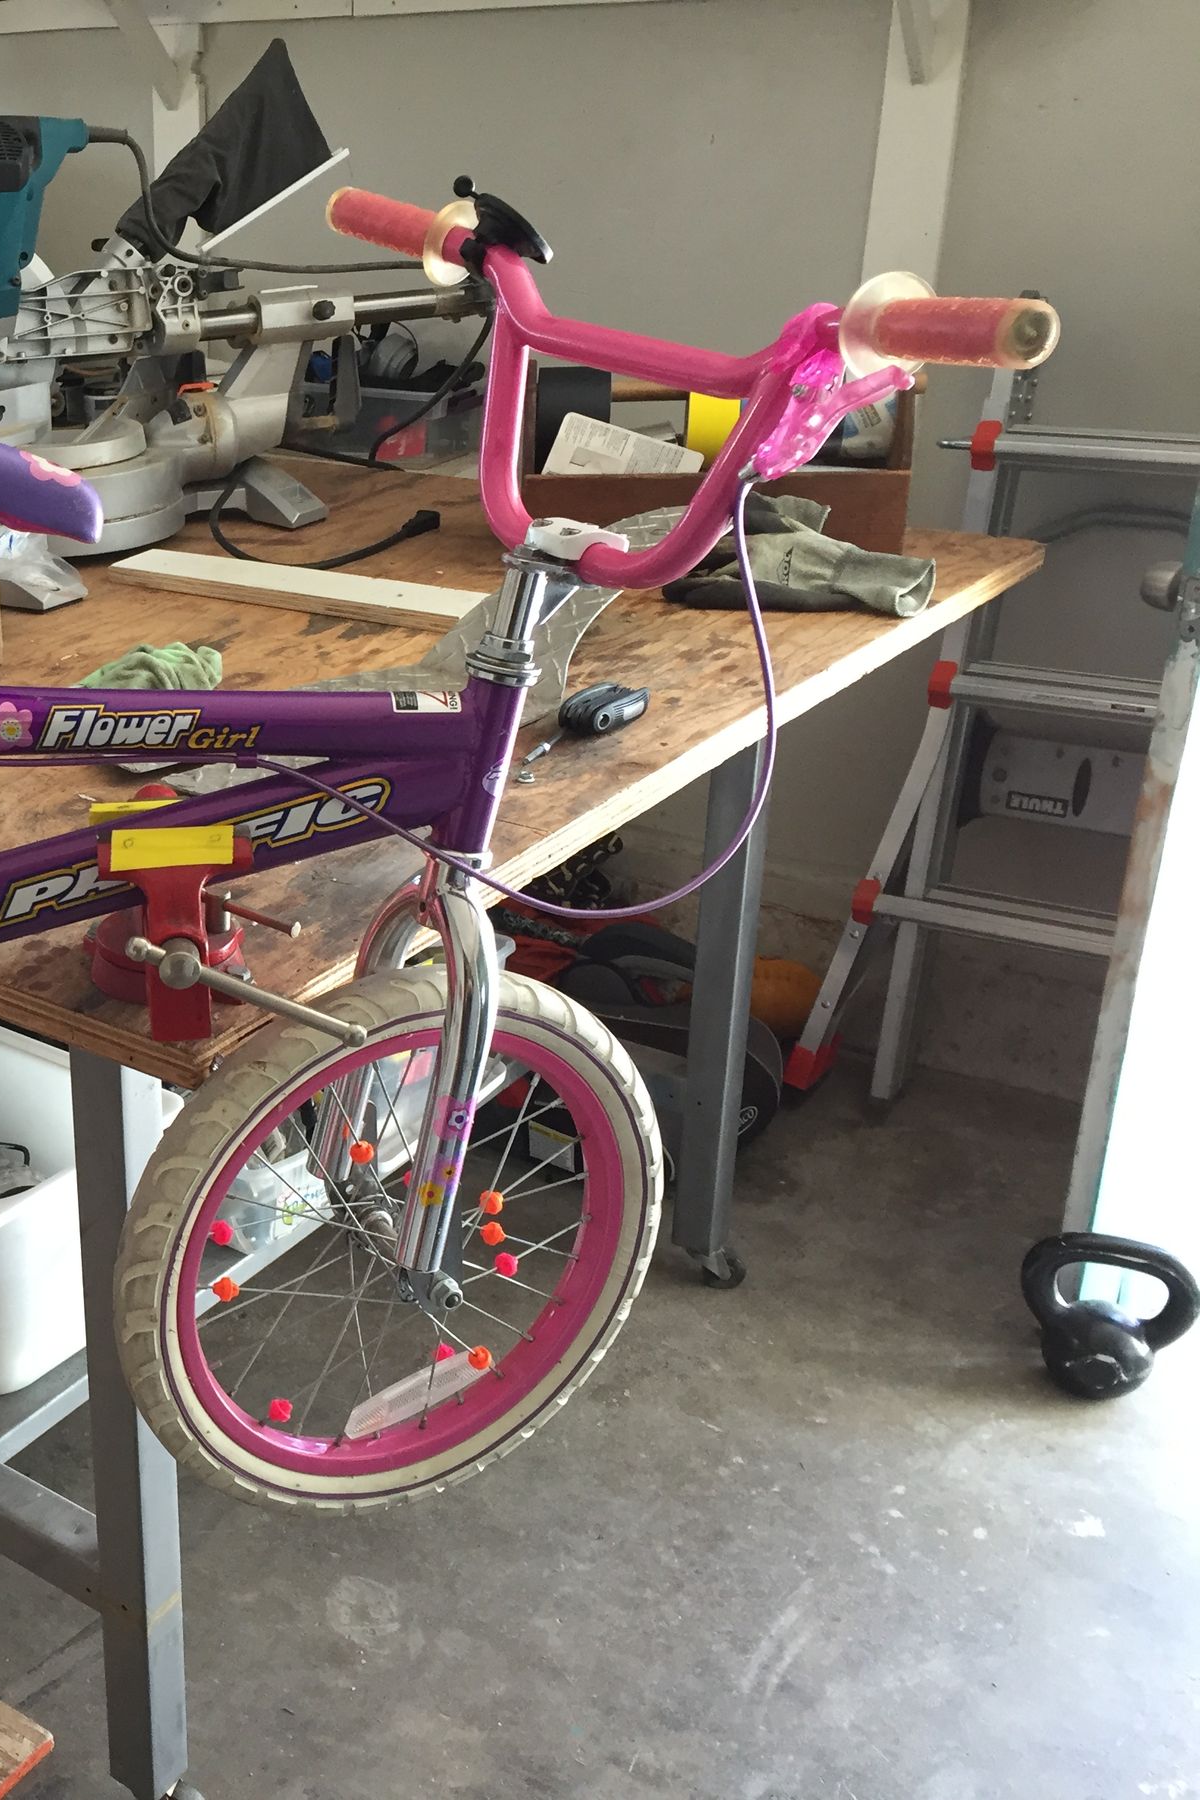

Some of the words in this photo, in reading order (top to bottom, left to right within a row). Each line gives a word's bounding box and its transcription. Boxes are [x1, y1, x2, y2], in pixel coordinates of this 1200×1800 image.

[41, 707, 195, 749] Flower
[187, 725, 261, 749] Girl
[1010, 793, 1064, 815] THULE
